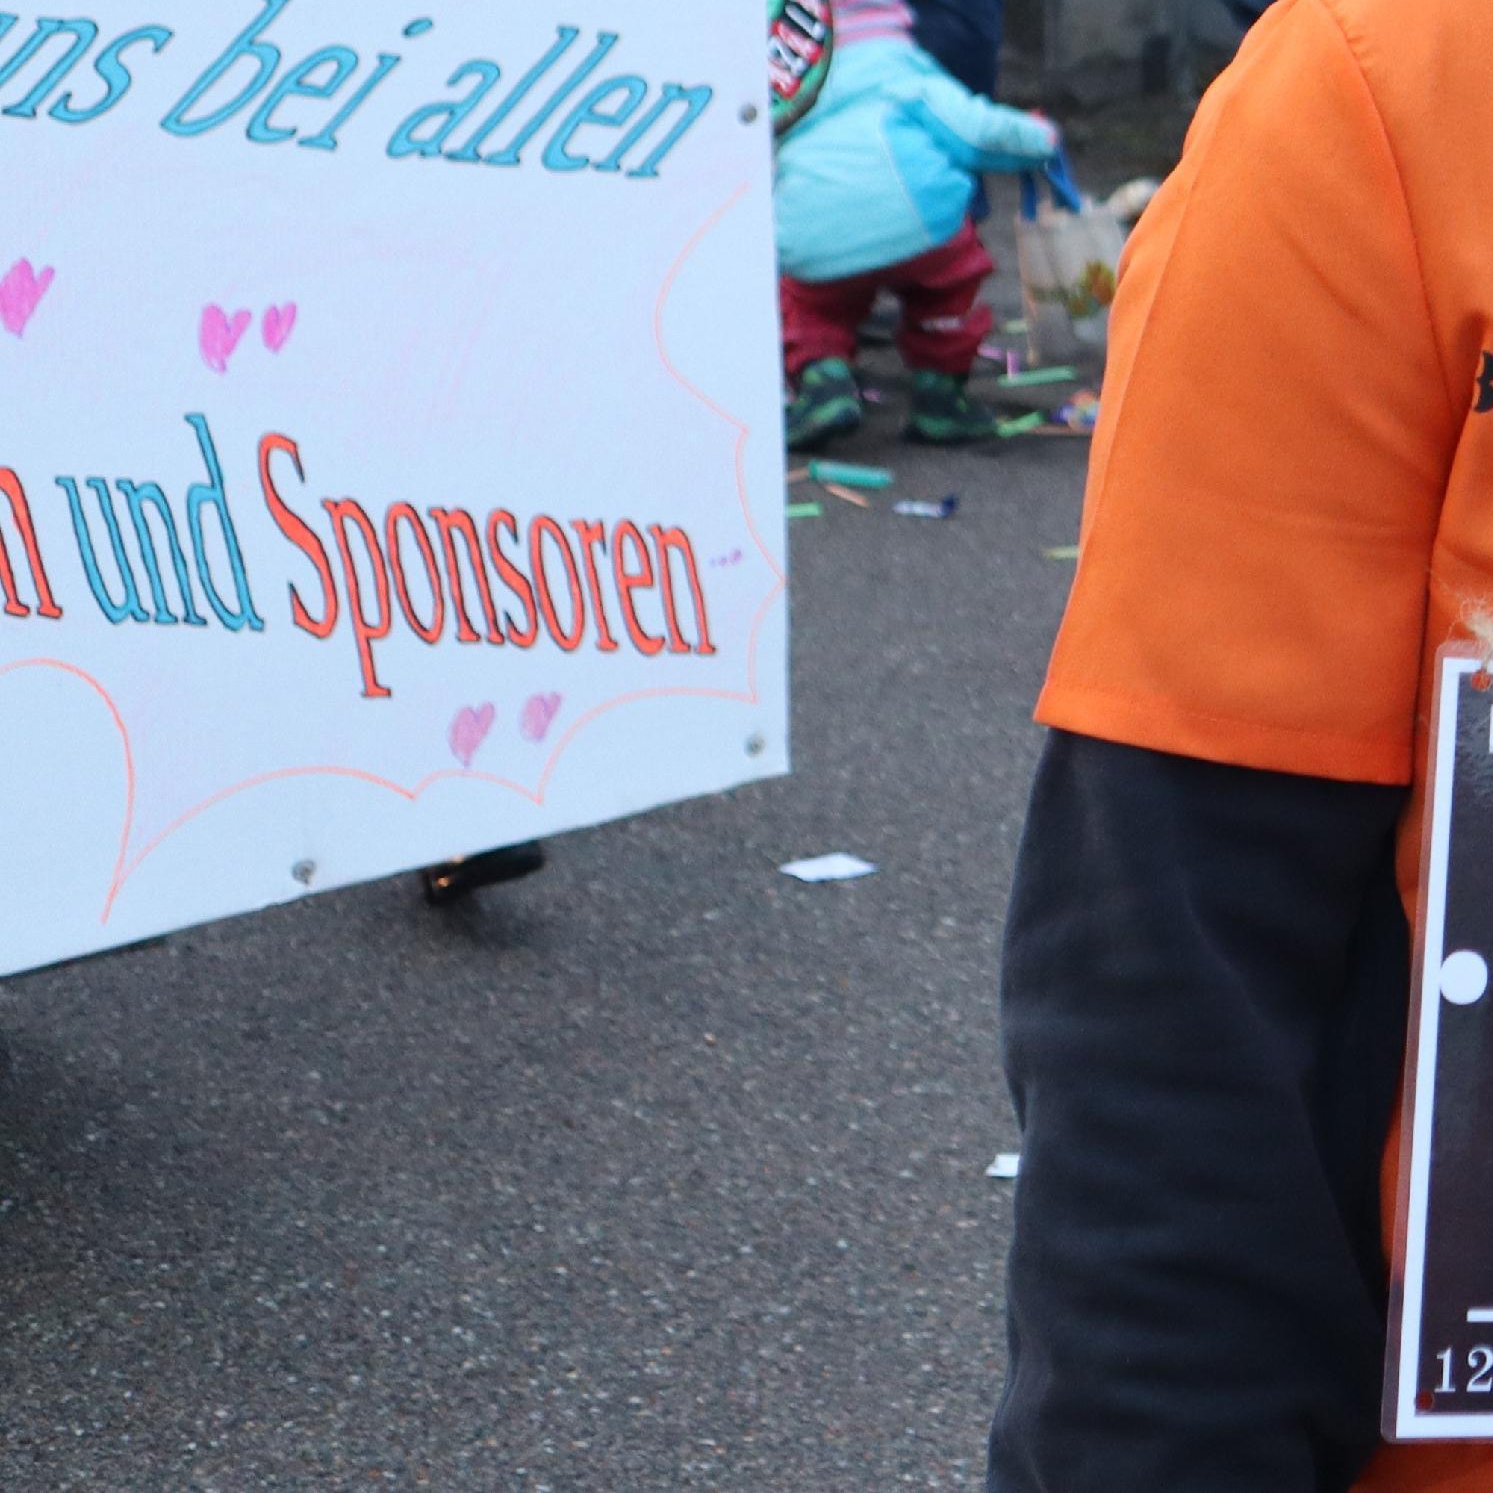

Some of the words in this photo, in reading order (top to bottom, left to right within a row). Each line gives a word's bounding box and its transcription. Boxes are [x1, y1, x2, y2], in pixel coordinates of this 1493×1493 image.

[0, 12, 174, 123] ns
[386, 24, 714, 178] allen
[54, 411, 266, 633] und
[257, 431, 717, 699] Sponsoren
